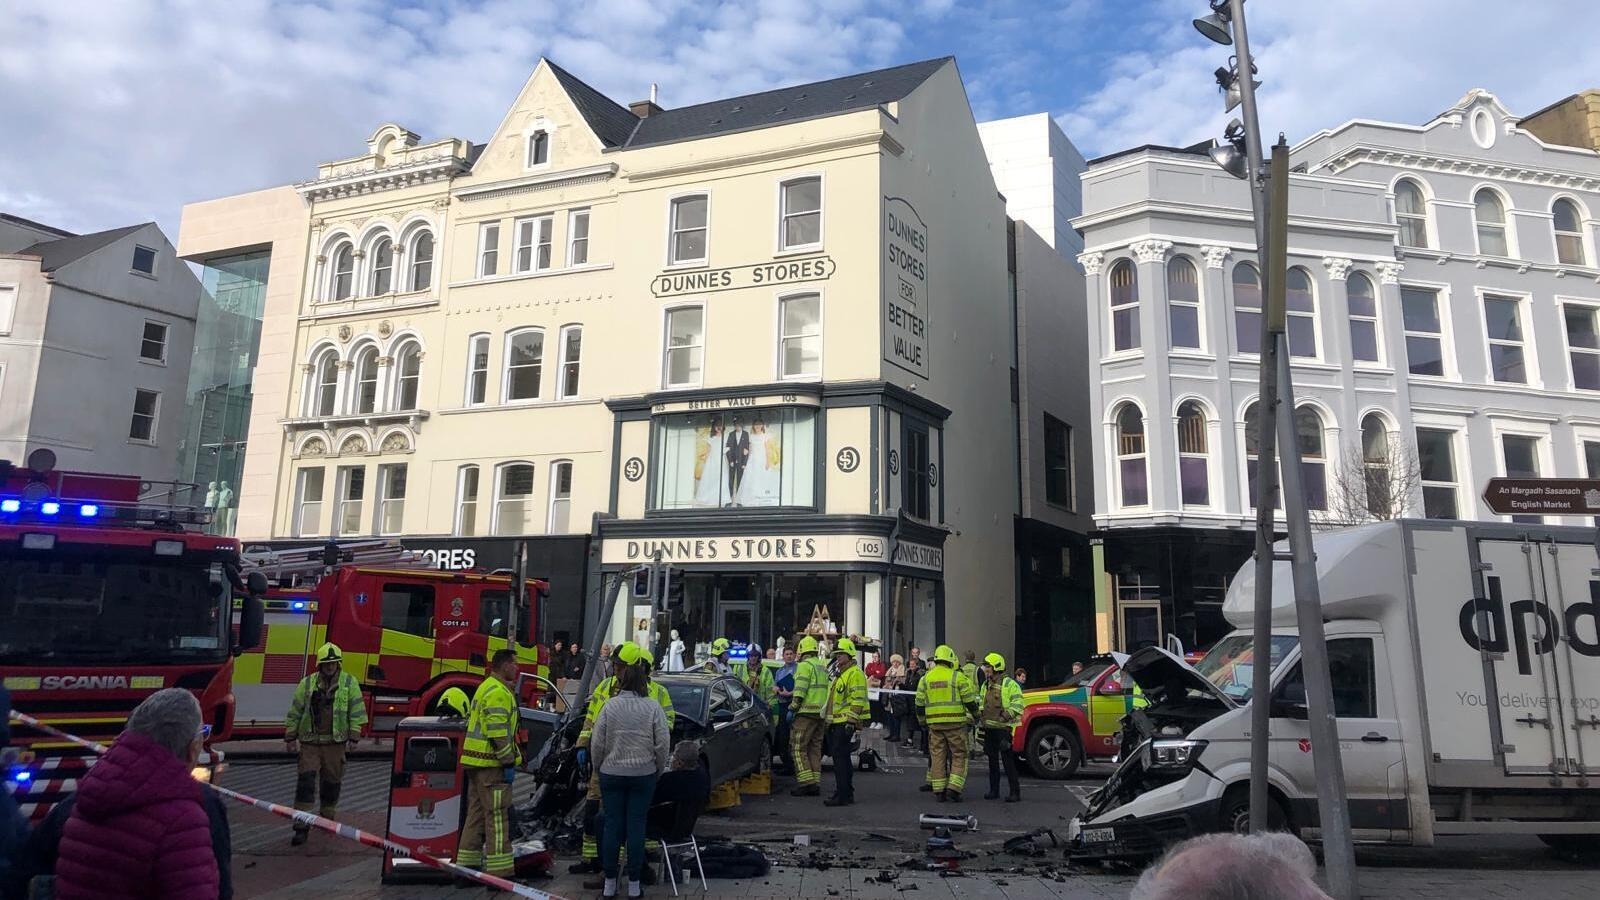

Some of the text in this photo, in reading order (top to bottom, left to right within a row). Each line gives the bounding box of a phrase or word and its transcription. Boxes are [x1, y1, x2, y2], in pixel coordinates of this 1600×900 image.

[889, 213, 925, 253] DUNNES
[889, 243, 925, 281] STORES
[661, 260, 826, 293] DUNNES STORES
[901, 283, 914, 299] FOR
[889, 302, 925, 339] BETTER
[893, 335, 922, 367] VALUE
[688, 396, 757, 410] BETTER VALUE
[781, 393, 797, 403] 105
[1511, 487, 1543, 496] Margadh
[1545, 487, 1581, 495] Sasanach
[1511, 500, 1541, 509] English
[626, 538, 816, 559] DUNNES STORES
[862, 542, 879, 553] 105
[920, 547, 941, 568] STORES
[402, 549, 475, 570] ORES
[1459, 576, 1600, 675] dpd
[42, 676, 128, 690] SCANIA
[1456, 691, 1488, 706] You
